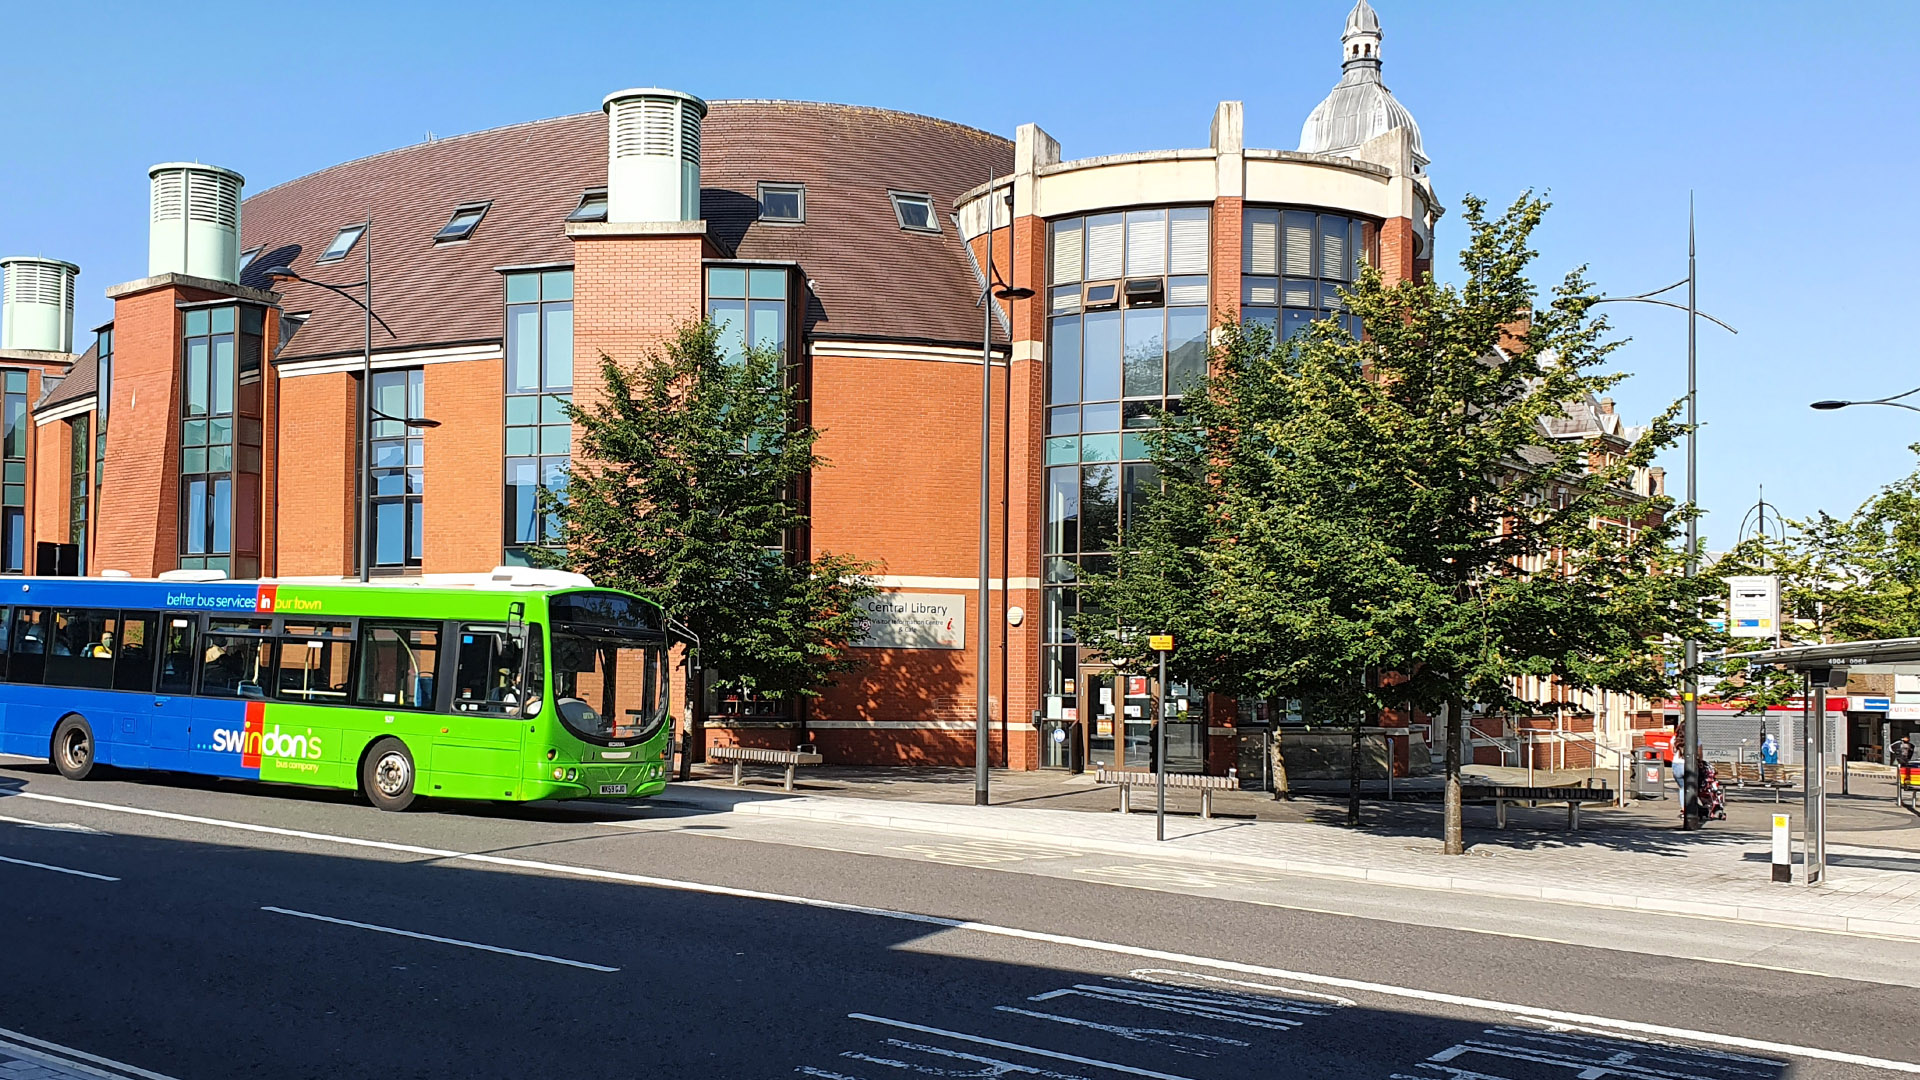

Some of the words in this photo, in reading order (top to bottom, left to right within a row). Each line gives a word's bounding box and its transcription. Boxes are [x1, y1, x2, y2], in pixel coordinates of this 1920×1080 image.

[166, 592, 196, 606] better
[197, 593, 215, 607] bus
[215, 594, 257, 609] services
[260, 594, 271, 609] in
[275, 598, 294, 609] our
[294, 595, 322, 610] town
[868, 602, 908, 613] Central
[911, 603, 948, 616] Library
[275, 759, 290, 769] bus
[289, 761, 320, 772] company
[993, 968, 1358, 1058] ONLY
